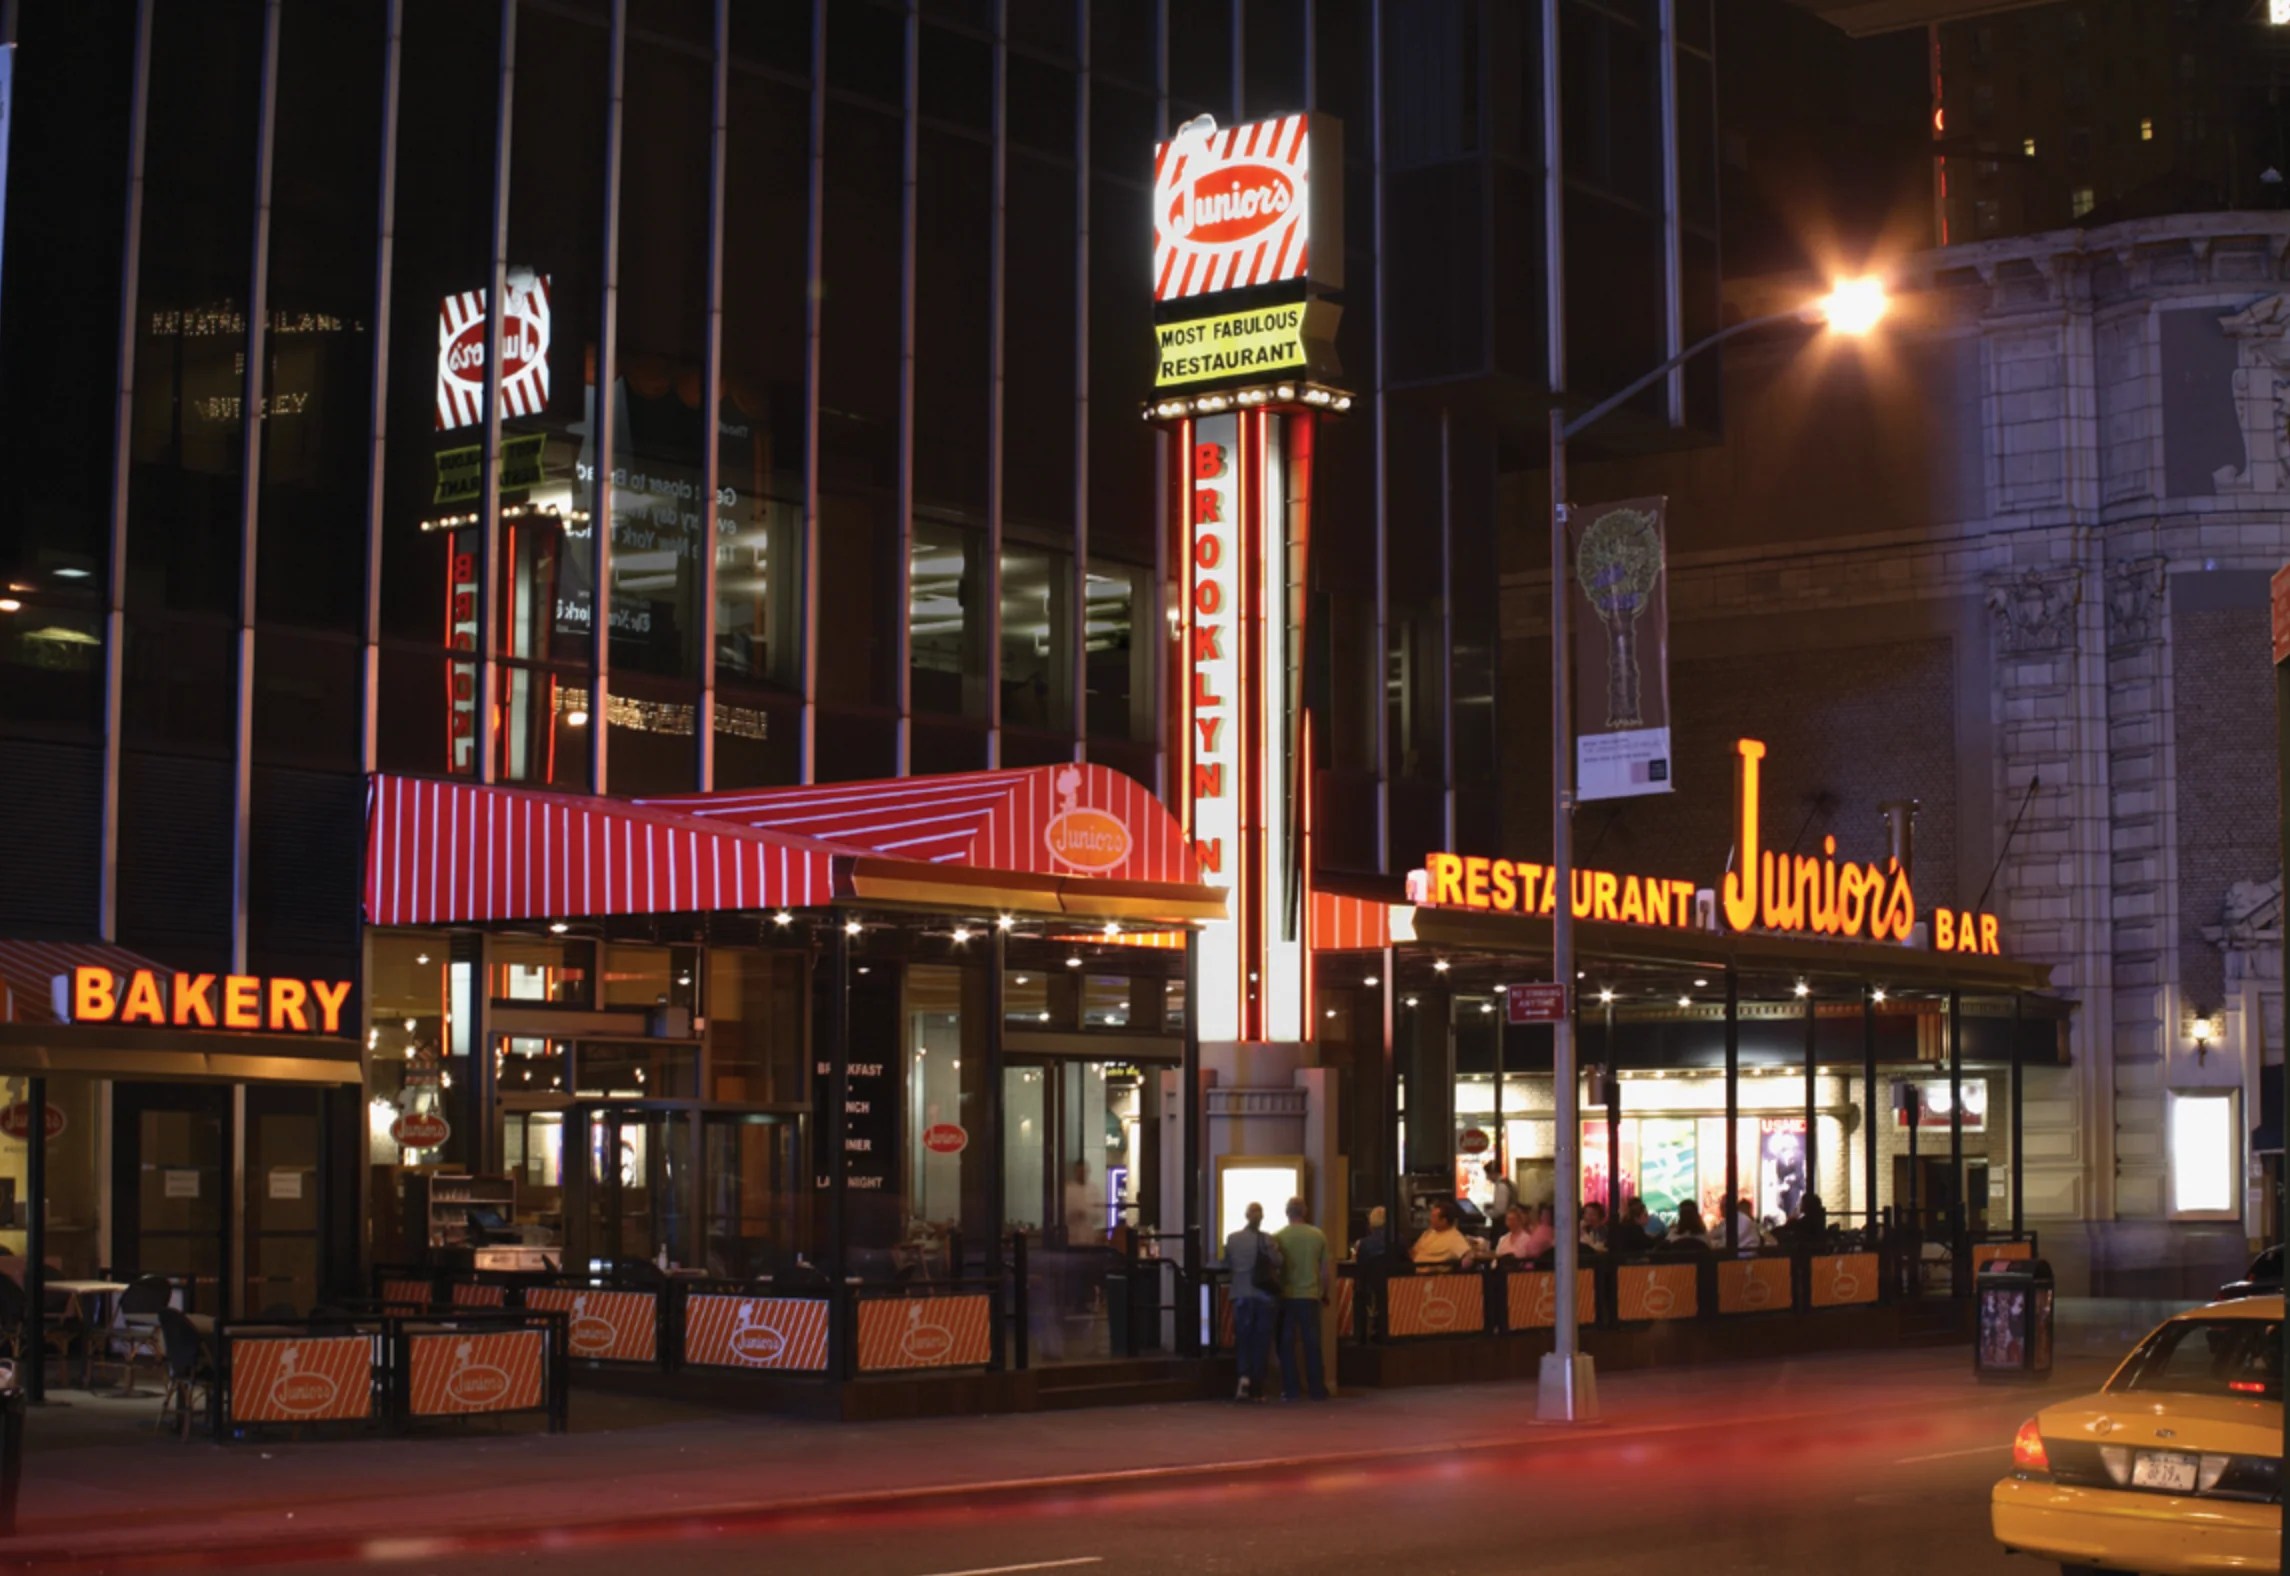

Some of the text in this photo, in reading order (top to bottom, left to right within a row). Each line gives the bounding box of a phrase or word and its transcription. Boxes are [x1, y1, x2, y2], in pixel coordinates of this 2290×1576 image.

[1171, 172, 1291, 238] Junior's
[1161, 310, 1298, 348] MOST FABULOUS
[1161, 341, 1298, 379] RESTAURANT
[1195, 442, 1222, 799] BROOKLYN
[1434, 737, 2001, 956] RESTAURANT Junior's BAR
[75, 965, 353, 1033] BAKERY
